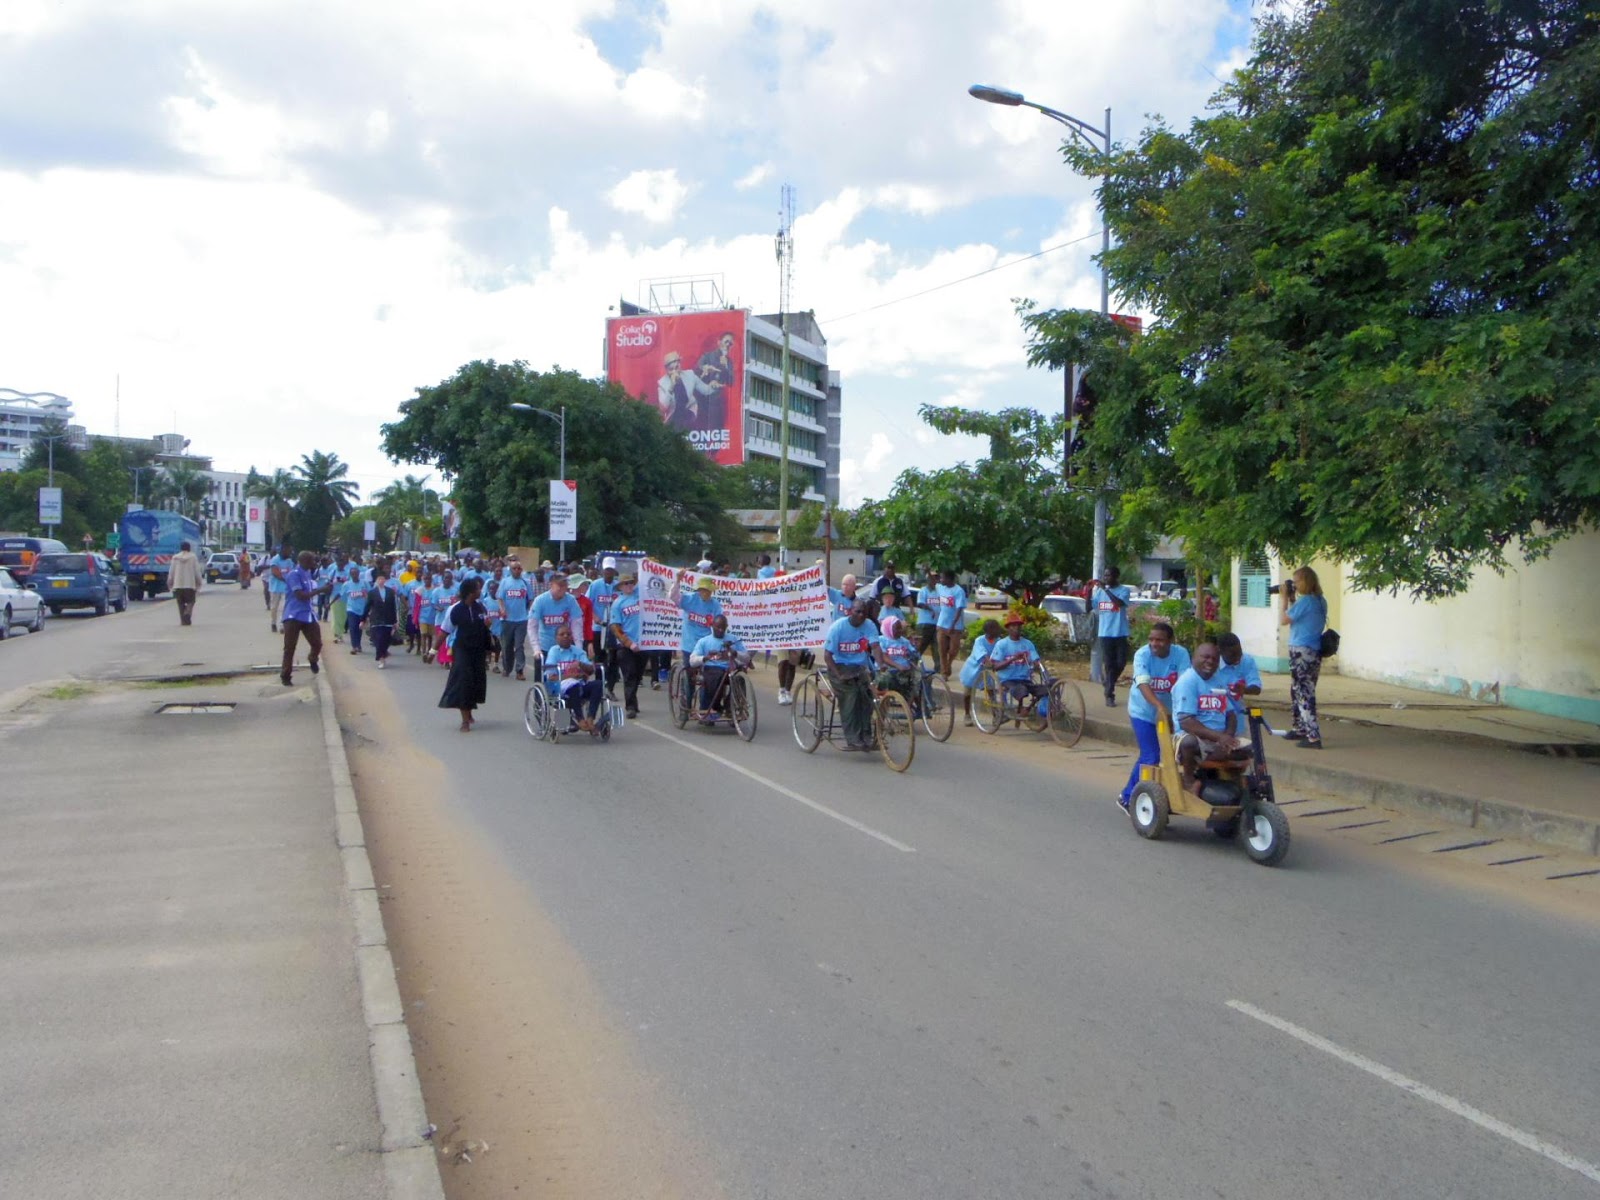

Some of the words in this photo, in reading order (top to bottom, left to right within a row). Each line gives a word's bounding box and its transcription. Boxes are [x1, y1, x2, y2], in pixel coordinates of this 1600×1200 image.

[615, 332, 652, 347] Studio
[686, 429, 731, 442] ONGE
[642, 559, 673, 579] CHAMA
[689, 613, 707, 624] ZERO
[743, 622, 784, 631] walemavu
[839, 643, 861, 653] ZERO
